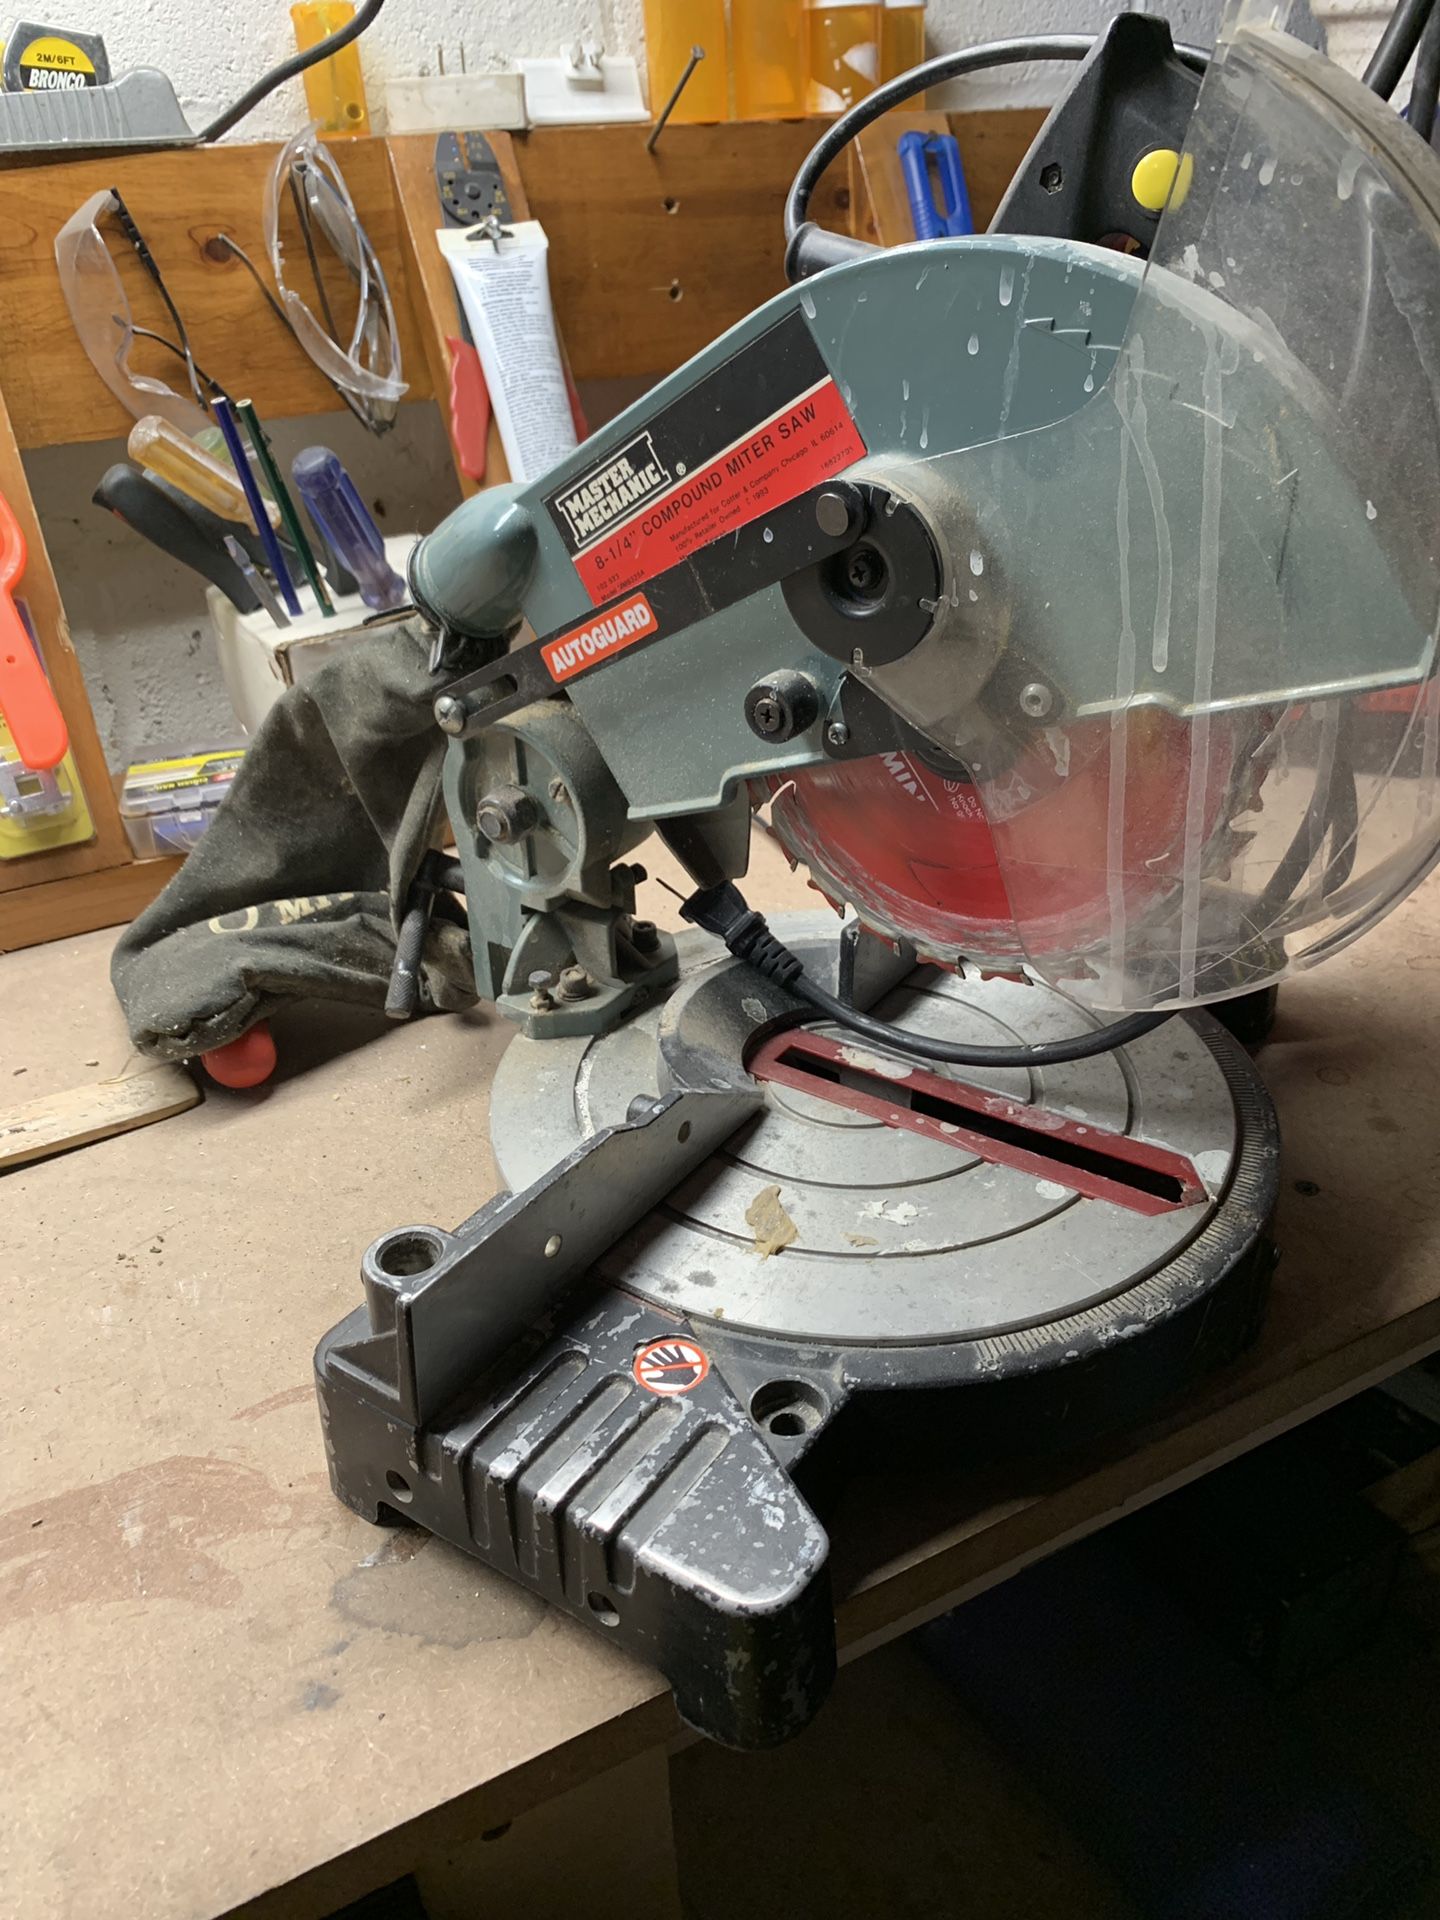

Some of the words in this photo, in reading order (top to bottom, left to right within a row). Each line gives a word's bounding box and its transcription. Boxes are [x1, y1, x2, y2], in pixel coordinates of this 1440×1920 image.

[29, 69, 86, 89] BRONCO
[36, 53, 76, 66] 2M/6FT
[565, 457, 635, 519] MASTER
[574, 462, 662, 537] MECHANIC
[641, 472, 722, 537] COMPOUND
[725, 434, 775, 477] MITER
[777, 402, 816, 439] SAW
[551, 603, 651, 674] AUTOGUARD
